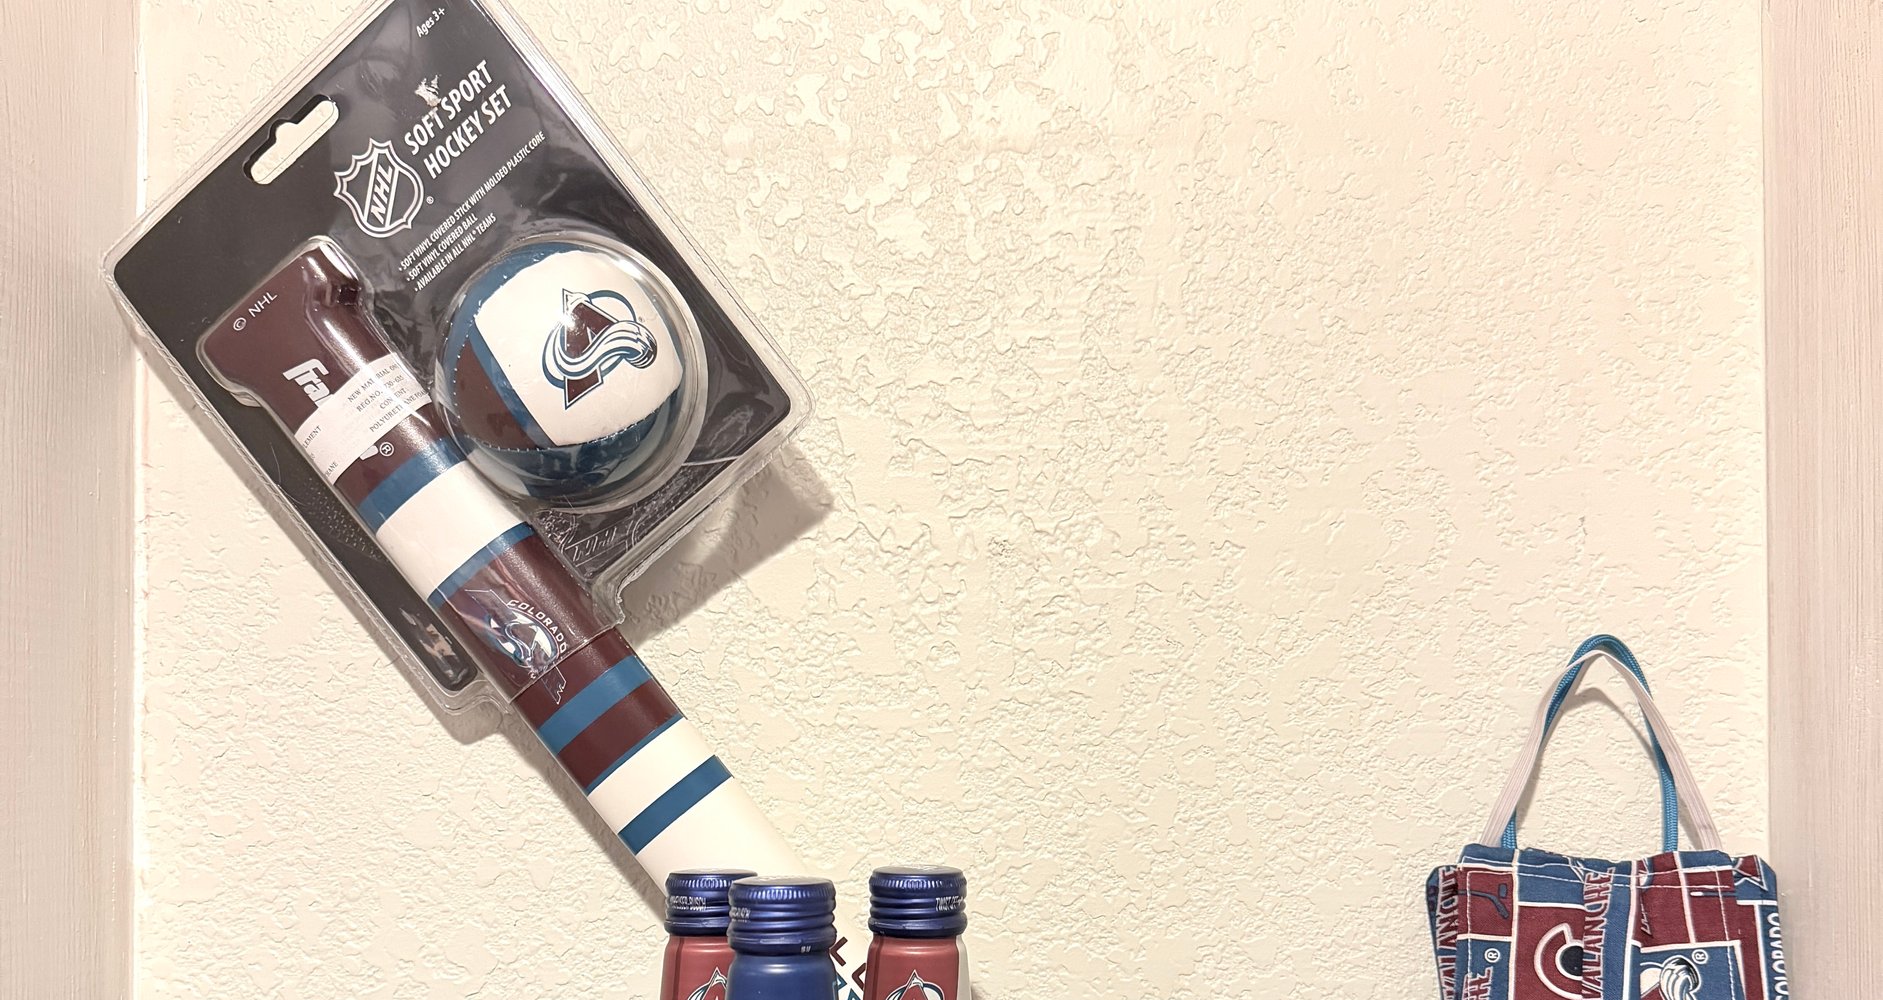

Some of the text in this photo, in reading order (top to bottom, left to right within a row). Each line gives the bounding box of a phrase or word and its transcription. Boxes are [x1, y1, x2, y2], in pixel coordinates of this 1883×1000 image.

[416, 7, 445, 38] Ages 3+
[404, 60, 493, 156] SOFT SPORT
[423, 84, 512, 180] HOCKEY SET
[371, 164, 393, 225] NHL
[400, 131, 546, 270] SOFT VINYL COVERED STICK WITH MOLDED PLASTIC CORE
[409, 213, 478, 281] SOFT VINYL COVERED BALL
[416, 262, 448, 292] AVAILABLE
[476, 212, 497, 235] TEAMS
[248, 292, 278, 318] NHL
[347, 389, 362, 403] NEW
[506, 599, 568, 654] COLORADO
